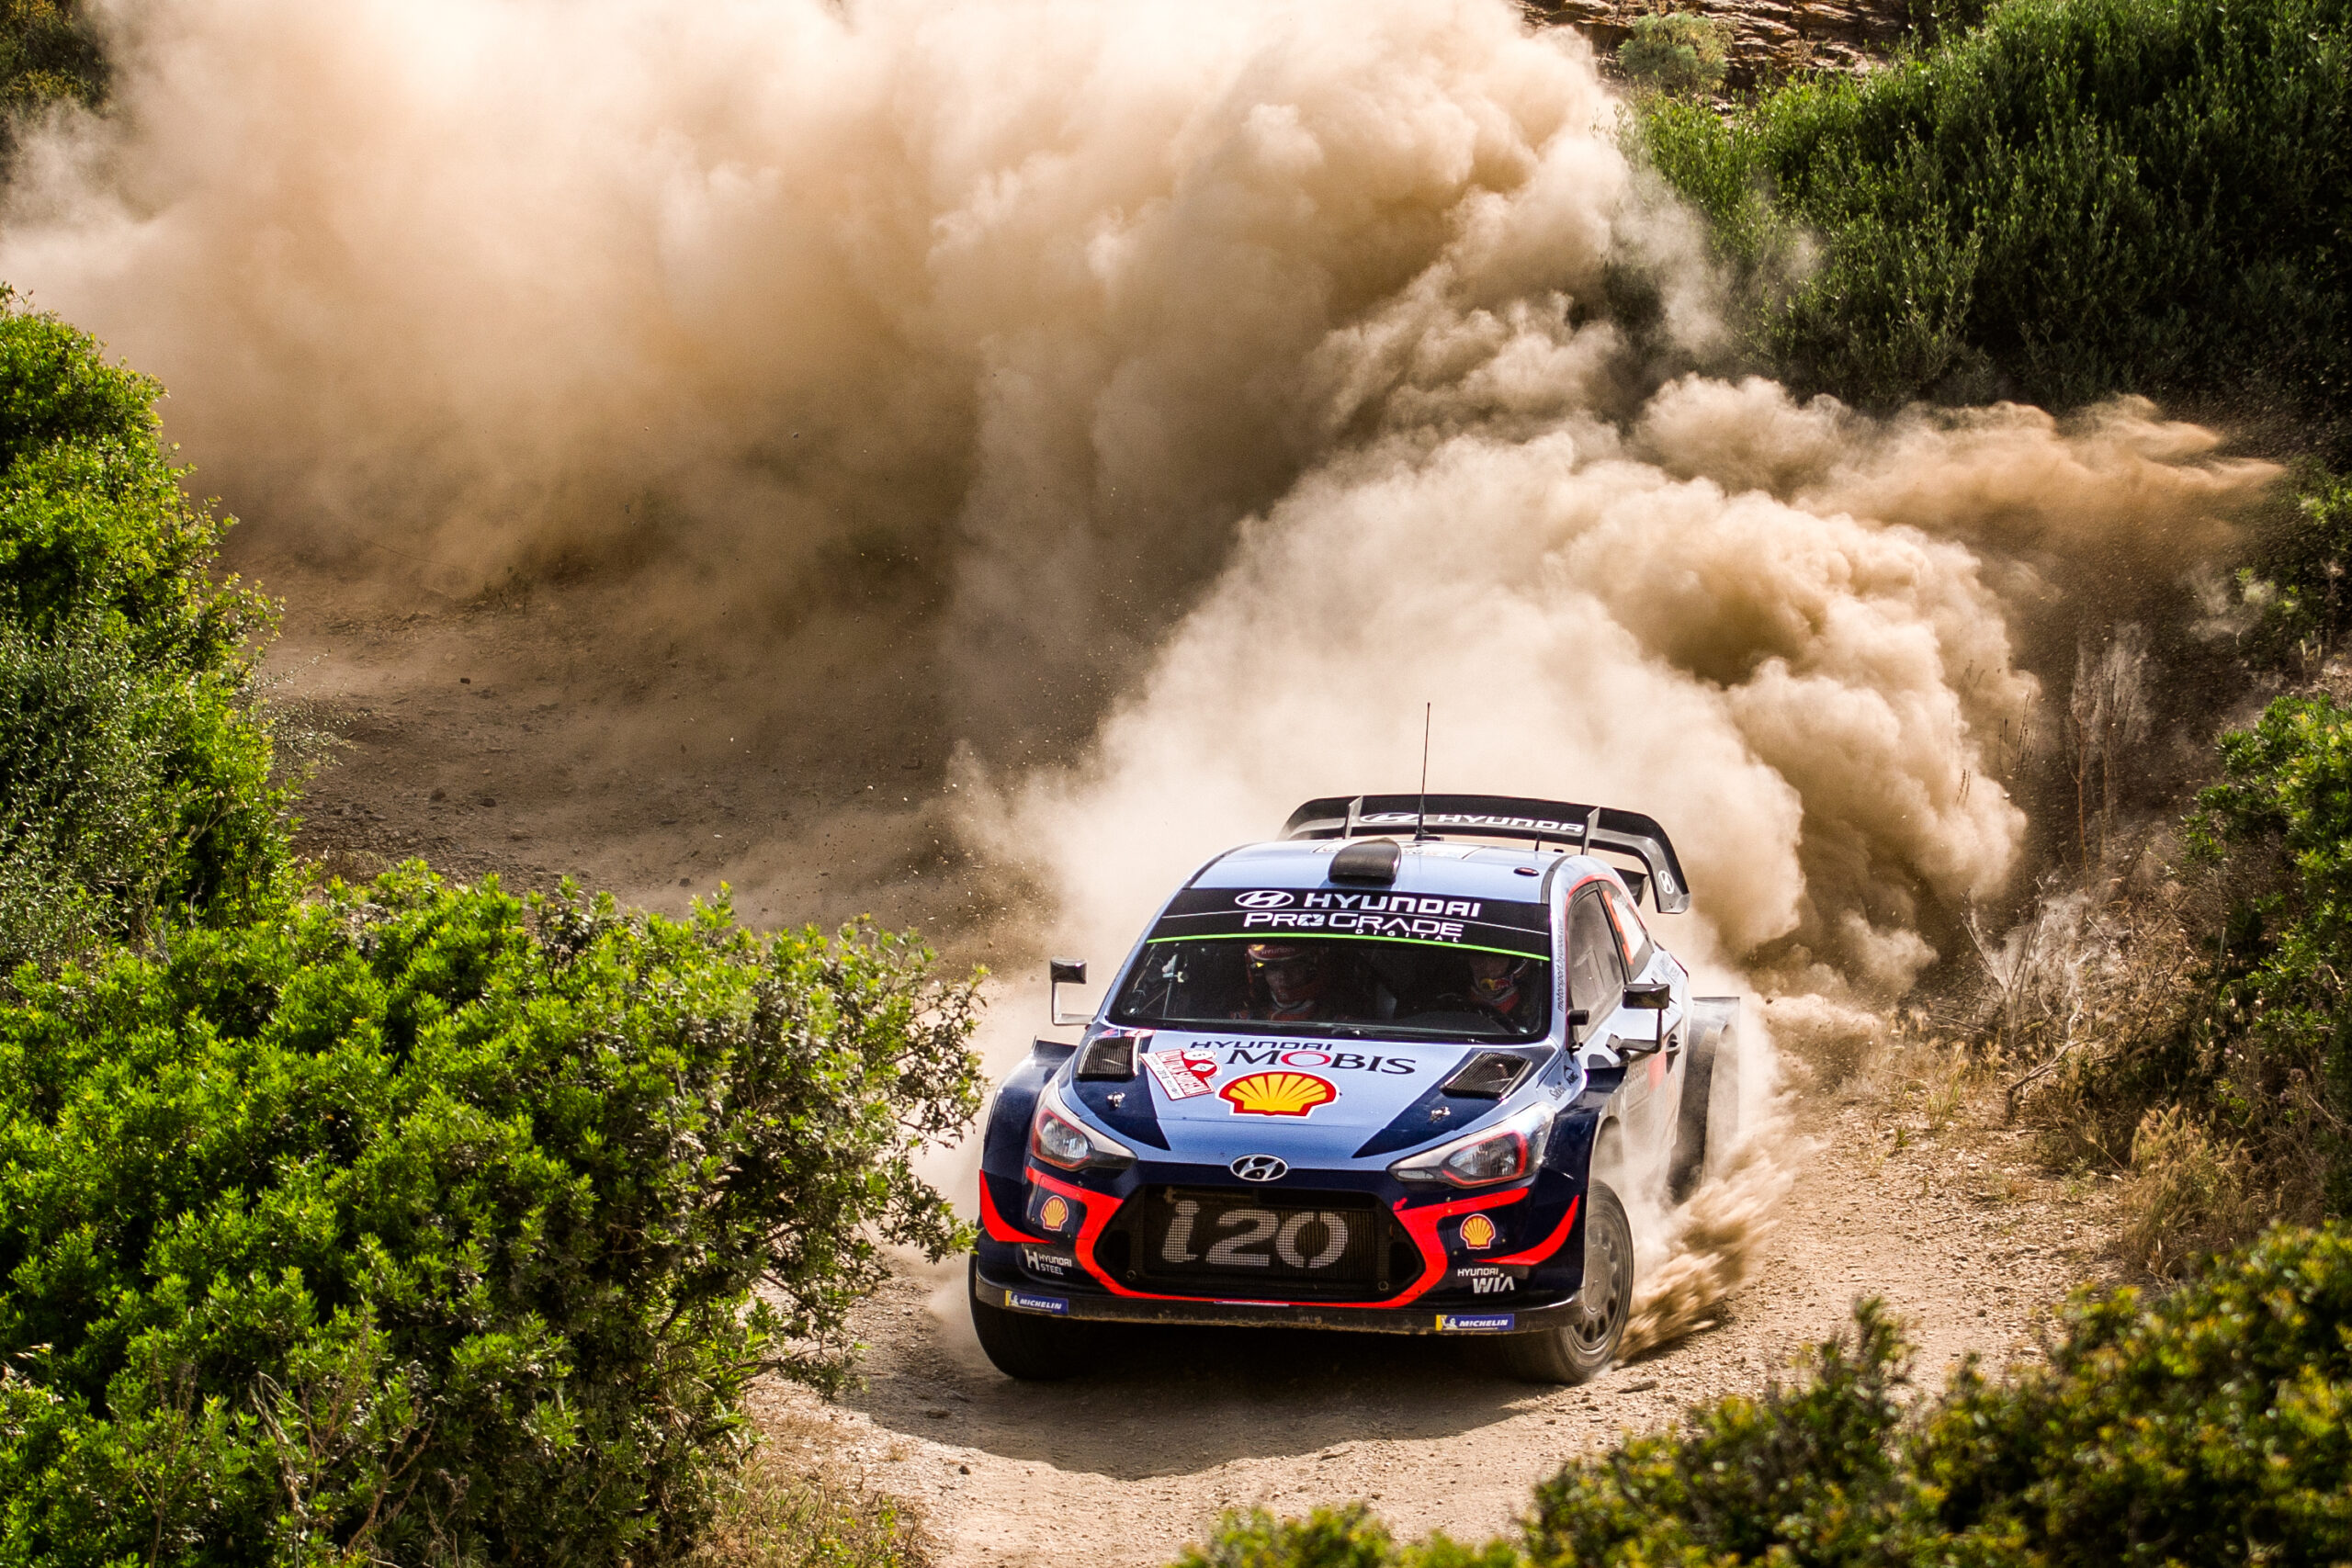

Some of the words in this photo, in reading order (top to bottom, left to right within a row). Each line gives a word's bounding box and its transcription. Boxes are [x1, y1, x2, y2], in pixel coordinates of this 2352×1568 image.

[1437, 814, 1584, 832] HYUNDA
[1304, 893, 1481, 917] HYUNDAI
[1355, 929, 1459, 942] DIGITAL
[1190, 1041, 1332, 1051] HYUNDAI
[1226, 1050, 1416, 1075] MOBIS
[1162, 1200, 1348, 1269] i20
[1039, 1253, 1072, 1268] HYUNDAI
[1040, 1264, 1064, 1275] STEEL
[1457, 1268, 1499, 1277] HYUNDAI
[1473, 1273, 1515, 1294] WIA
[1020, 1298, 1062, 1310] MICHELIN
[1459, 1319, 1509, 1328] MICHELIN
